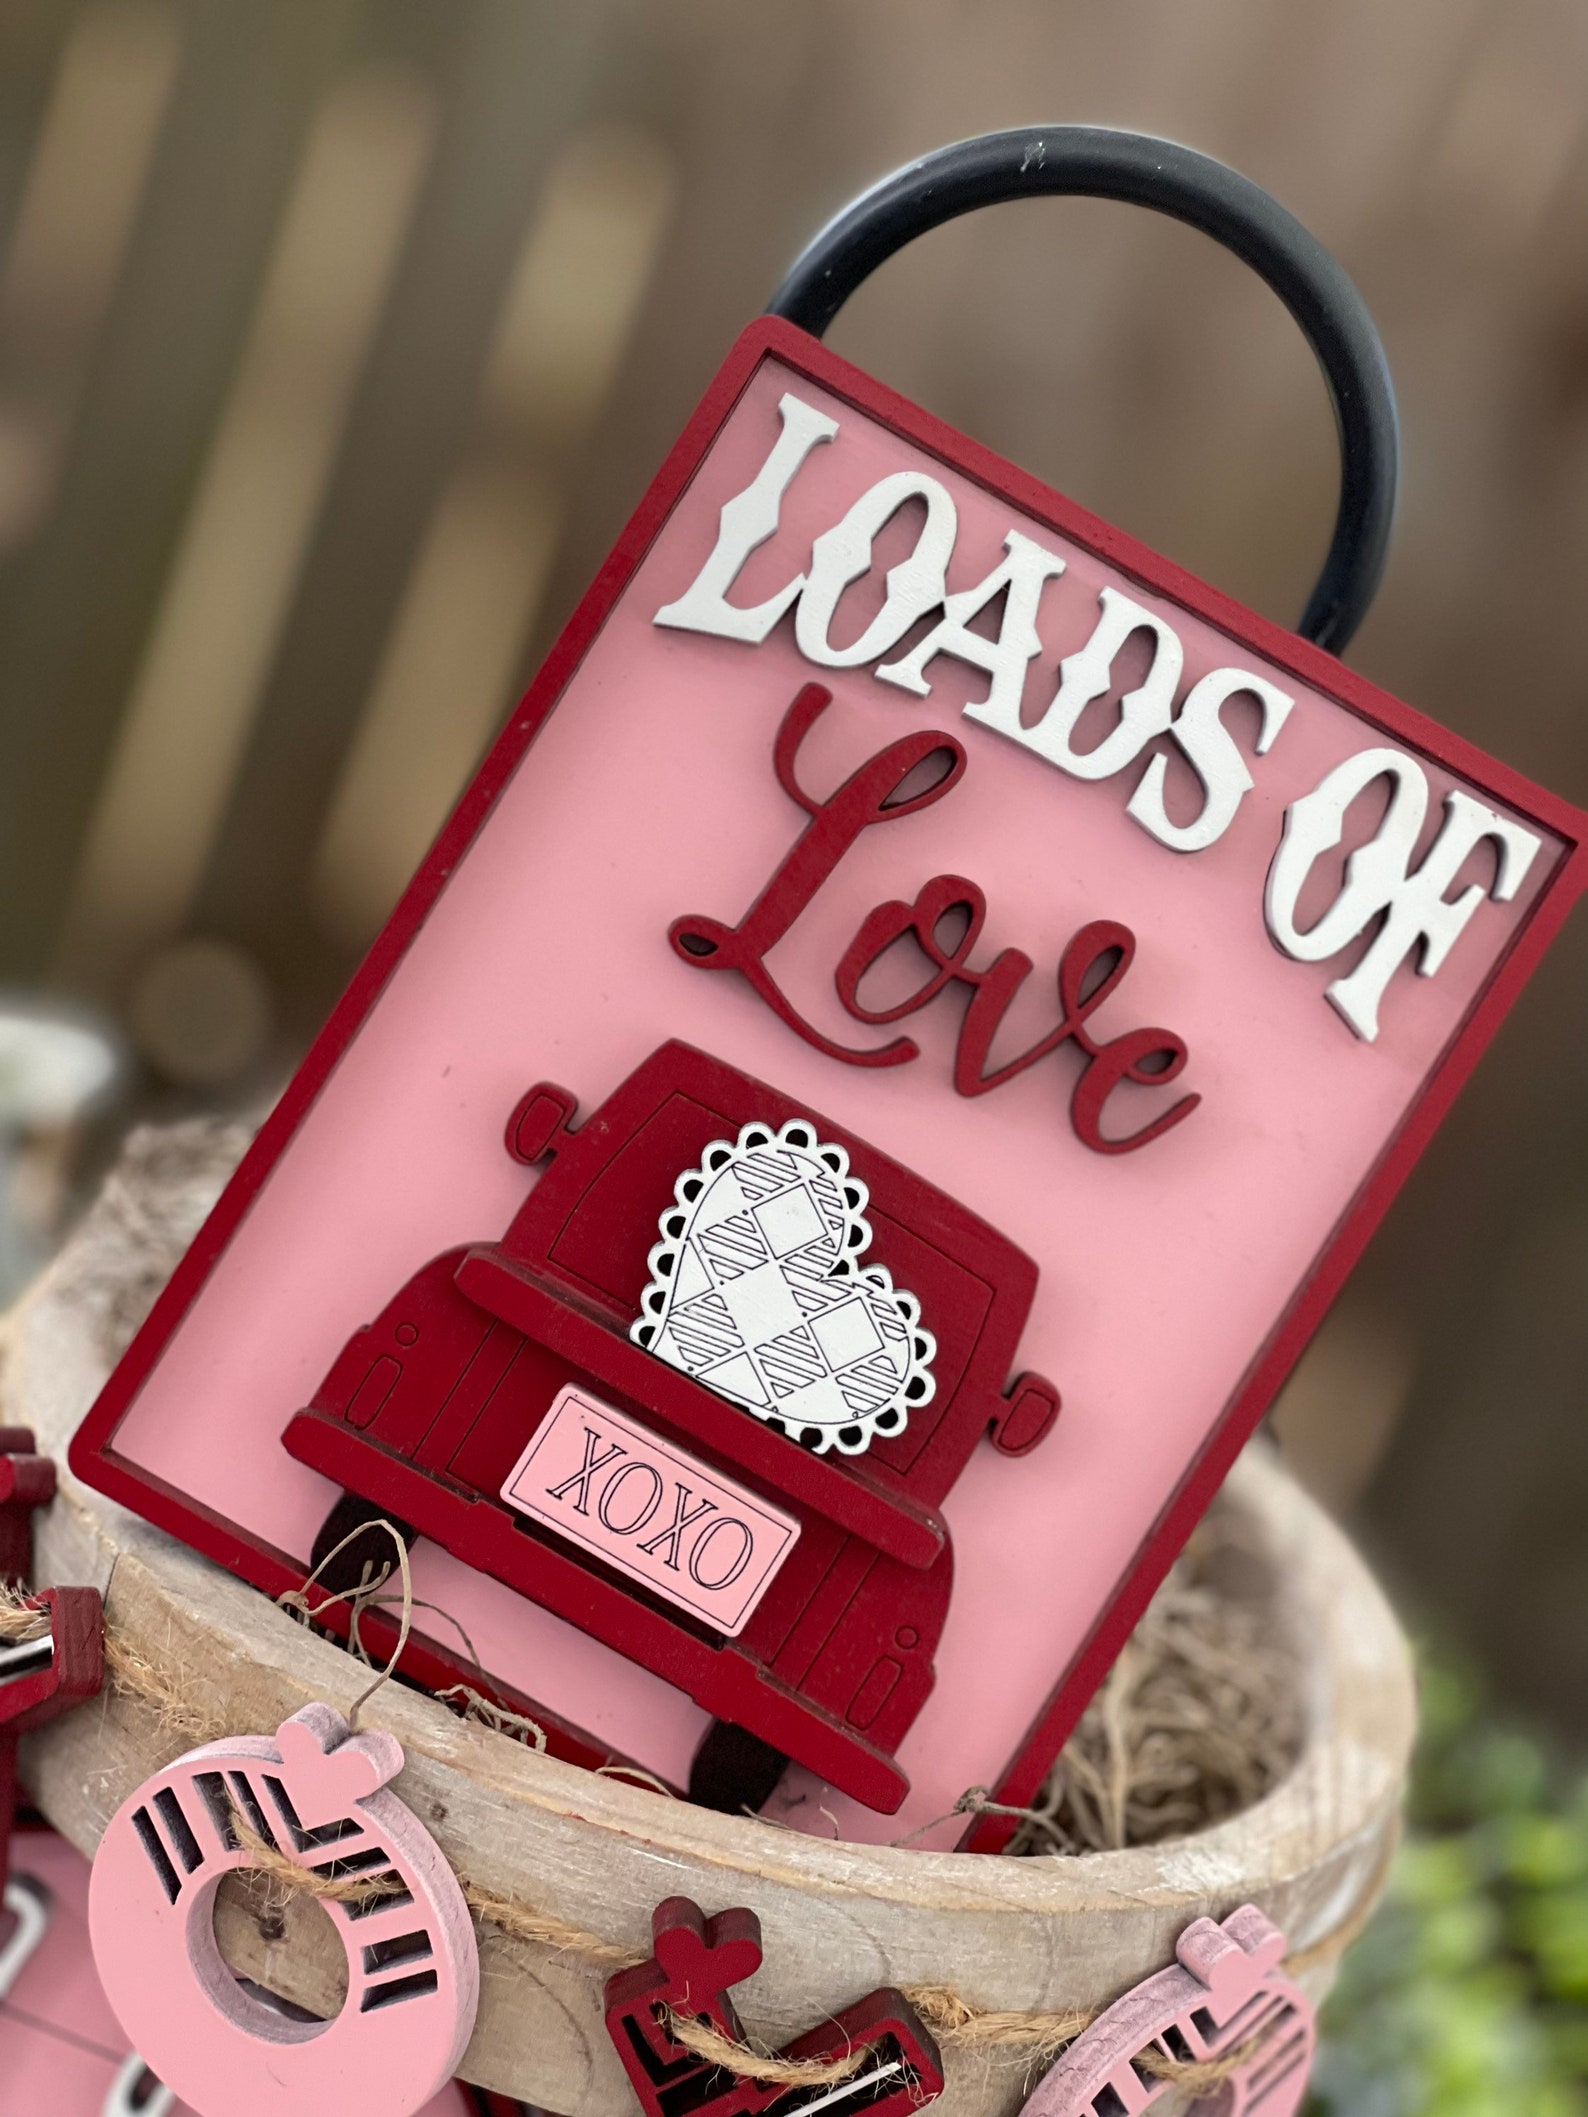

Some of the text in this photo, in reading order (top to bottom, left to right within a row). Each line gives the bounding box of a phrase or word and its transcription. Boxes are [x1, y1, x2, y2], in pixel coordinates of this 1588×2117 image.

[653, 392, 1541, 1043] LOADS OF
[668, 682, 1202, 1155] Love
[545, 1426, 754, 1591] XOXO
